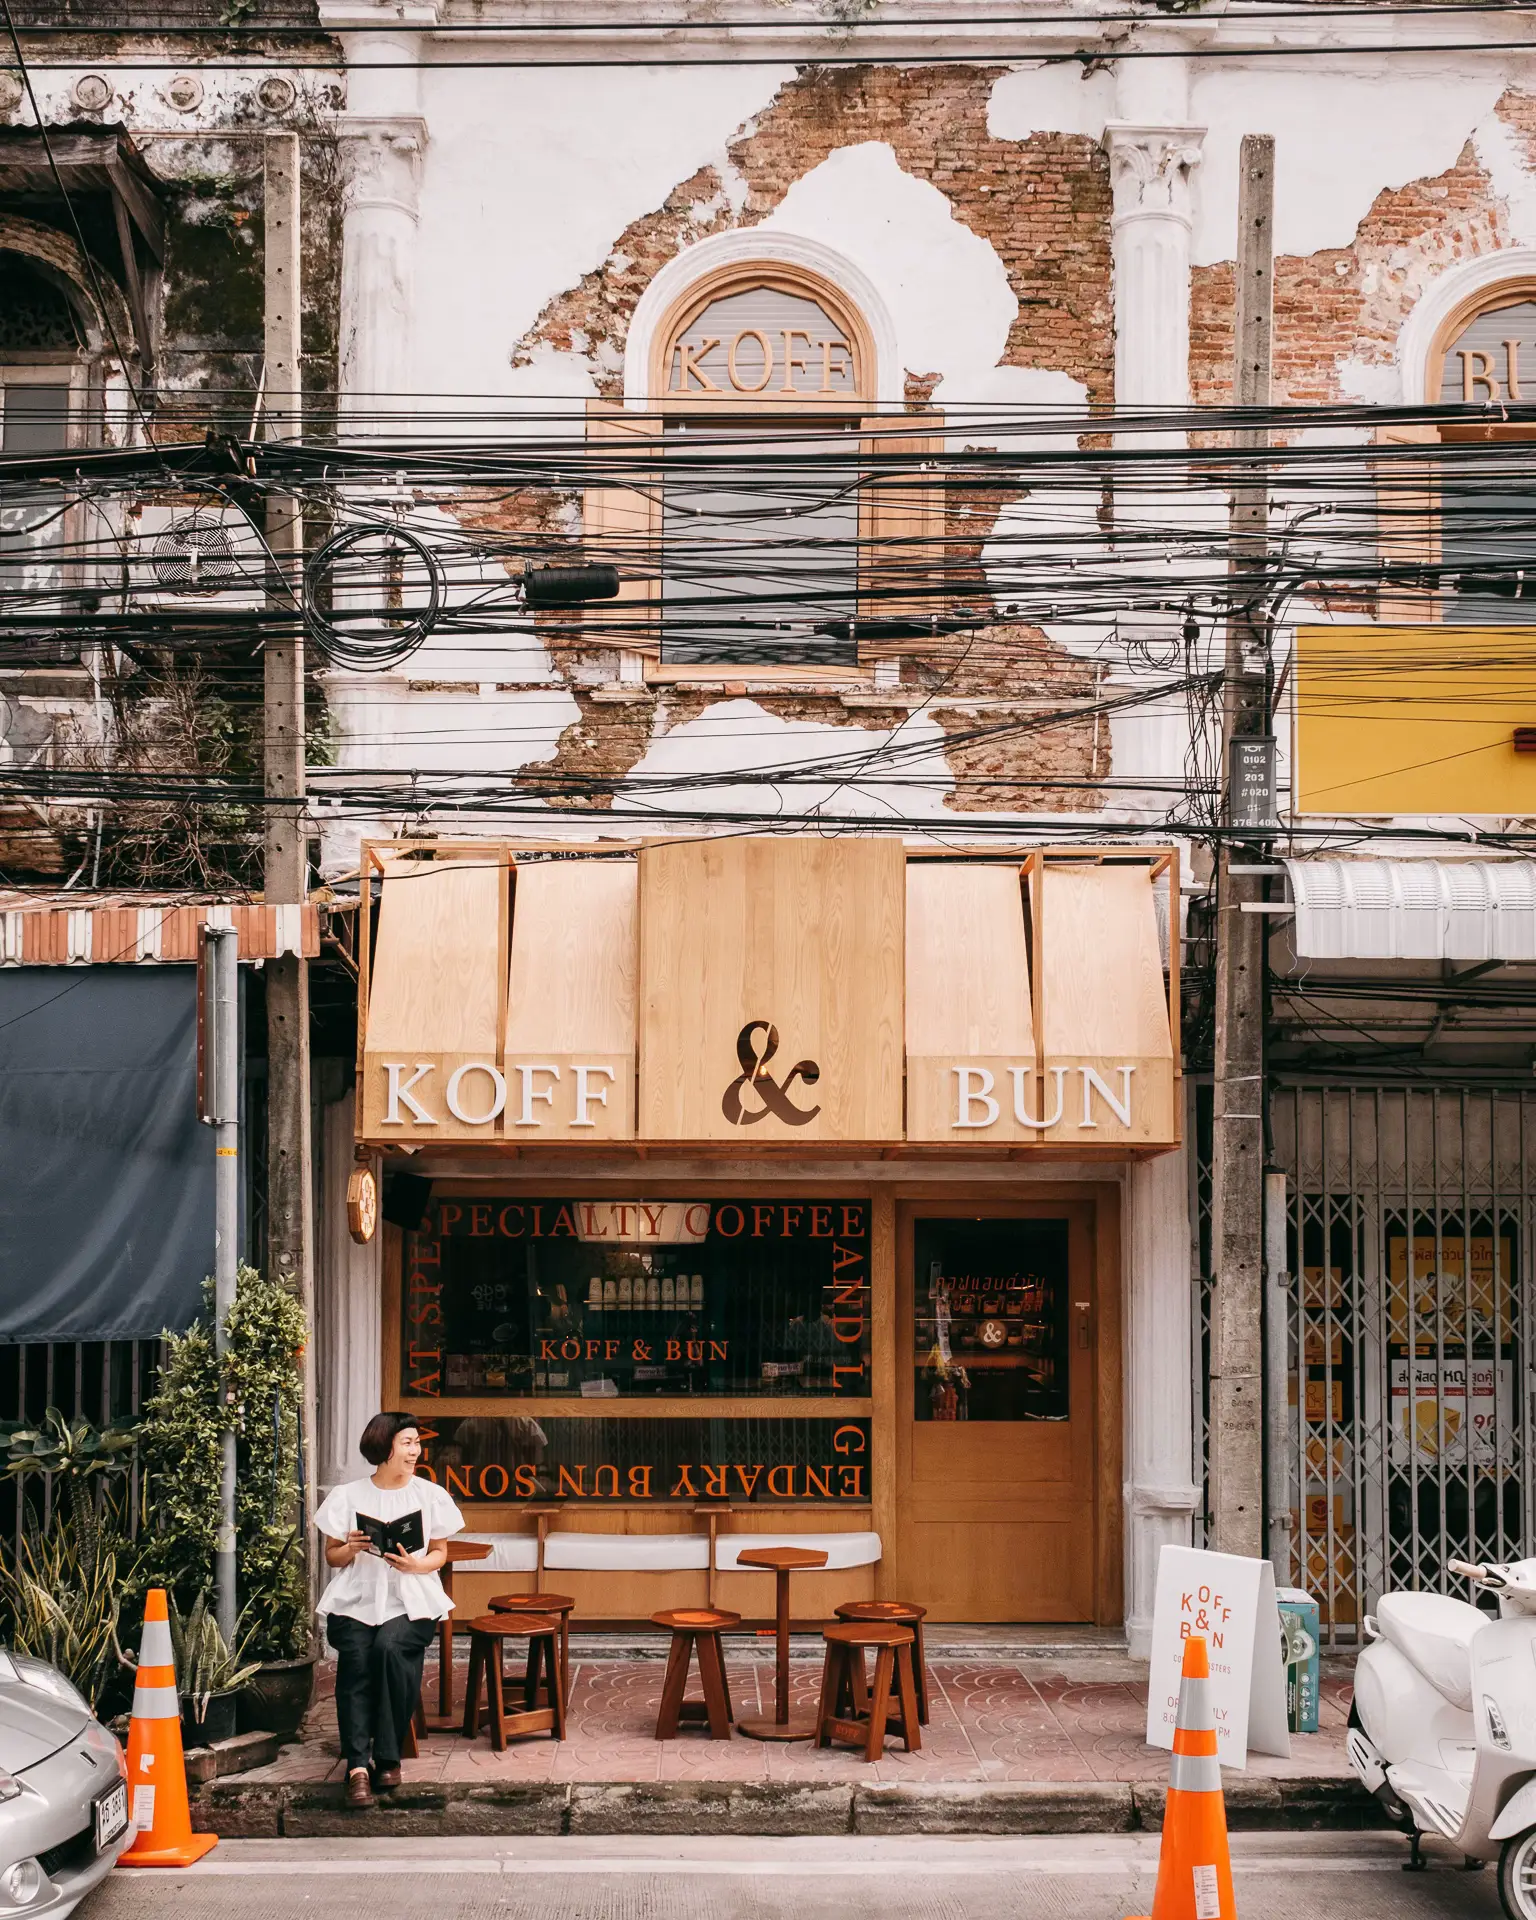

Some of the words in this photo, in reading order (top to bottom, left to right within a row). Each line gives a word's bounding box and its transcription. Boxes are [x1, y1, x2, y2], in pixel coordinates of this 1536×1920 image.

[675, 327, 852, 392] KOFF
[1243, 756, 1266, 764] 0102
[381, 1063, 616, 1126] KOFF
[722, 1020, 822, 1126] &
[952, 1066, 1137, 1128] BUN
[685, 1204, 866, 1238] COFFEE
[833, 1241, 865, 1343] AND
[983, 1322, 1002, 1343] &
[539, 1339, 621, 1361] KOFF
[631, 1339, 653, 1361] &
[665, 1339, 730, 1361] BUN
[558, 1464, 653, 1497] BUN
[1195, 1608, 1210, 1631] &
[1180, 1621, 1225, 1649] BN
